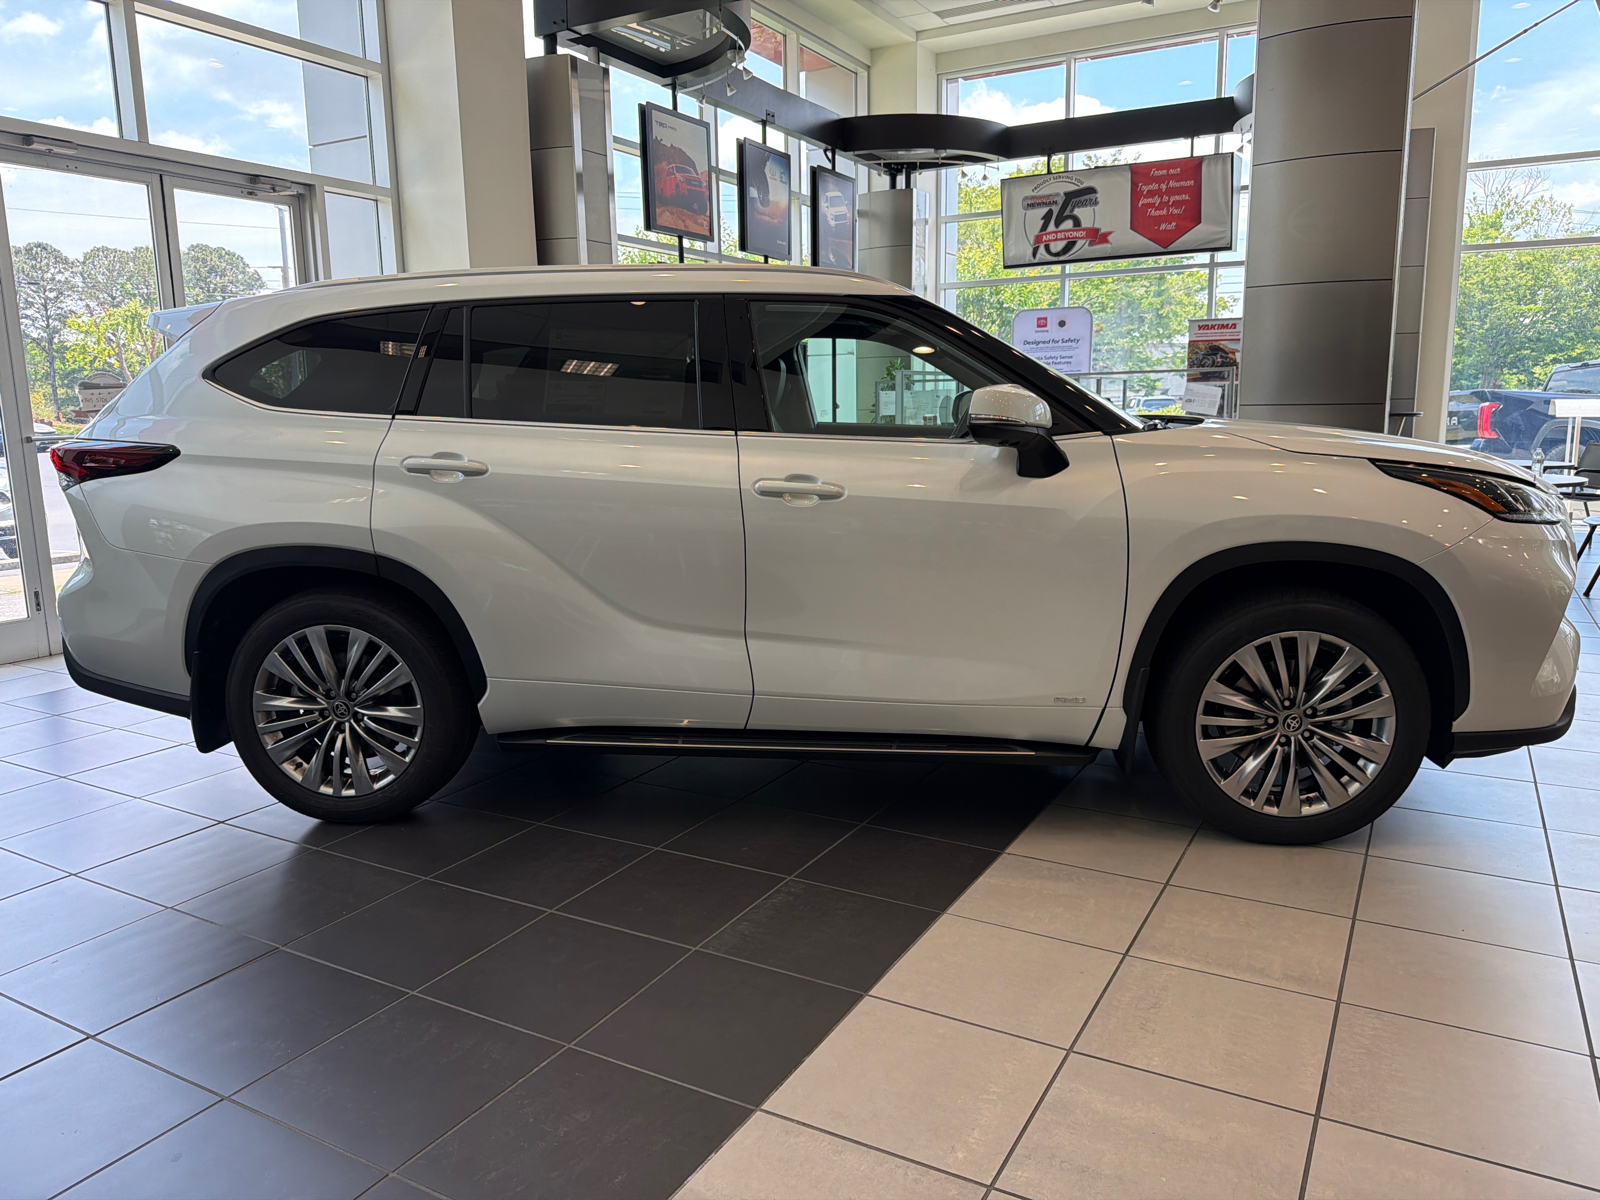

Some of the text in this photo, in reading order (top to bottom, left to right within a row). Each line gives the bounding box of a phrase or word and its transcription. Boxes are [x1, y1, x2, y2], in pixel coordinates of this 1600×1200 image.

[1150, 168, 1168, 176] From
[1032, 177, 1052, 193] PROUDLY
[1074, 177, 1085, 186] YOU
[1137, 183, 1159, 194] Toyota
[1160, 180, 1168, 192] of
[1026, 200, 1058, 208] NEWNAN
[1070, 196, 1100, 214] years
[1138, 194, 1191, 208] family to yours.
[1146, 206, 1186, 216] Thank You!
[1032, 186, 1098, 260] 15
[1160, 222, 1176, 230] Walt
[1042, 230, 1086, 241] AND BEYOND!
[1197, 322, 1237, 331] YAKIMA
